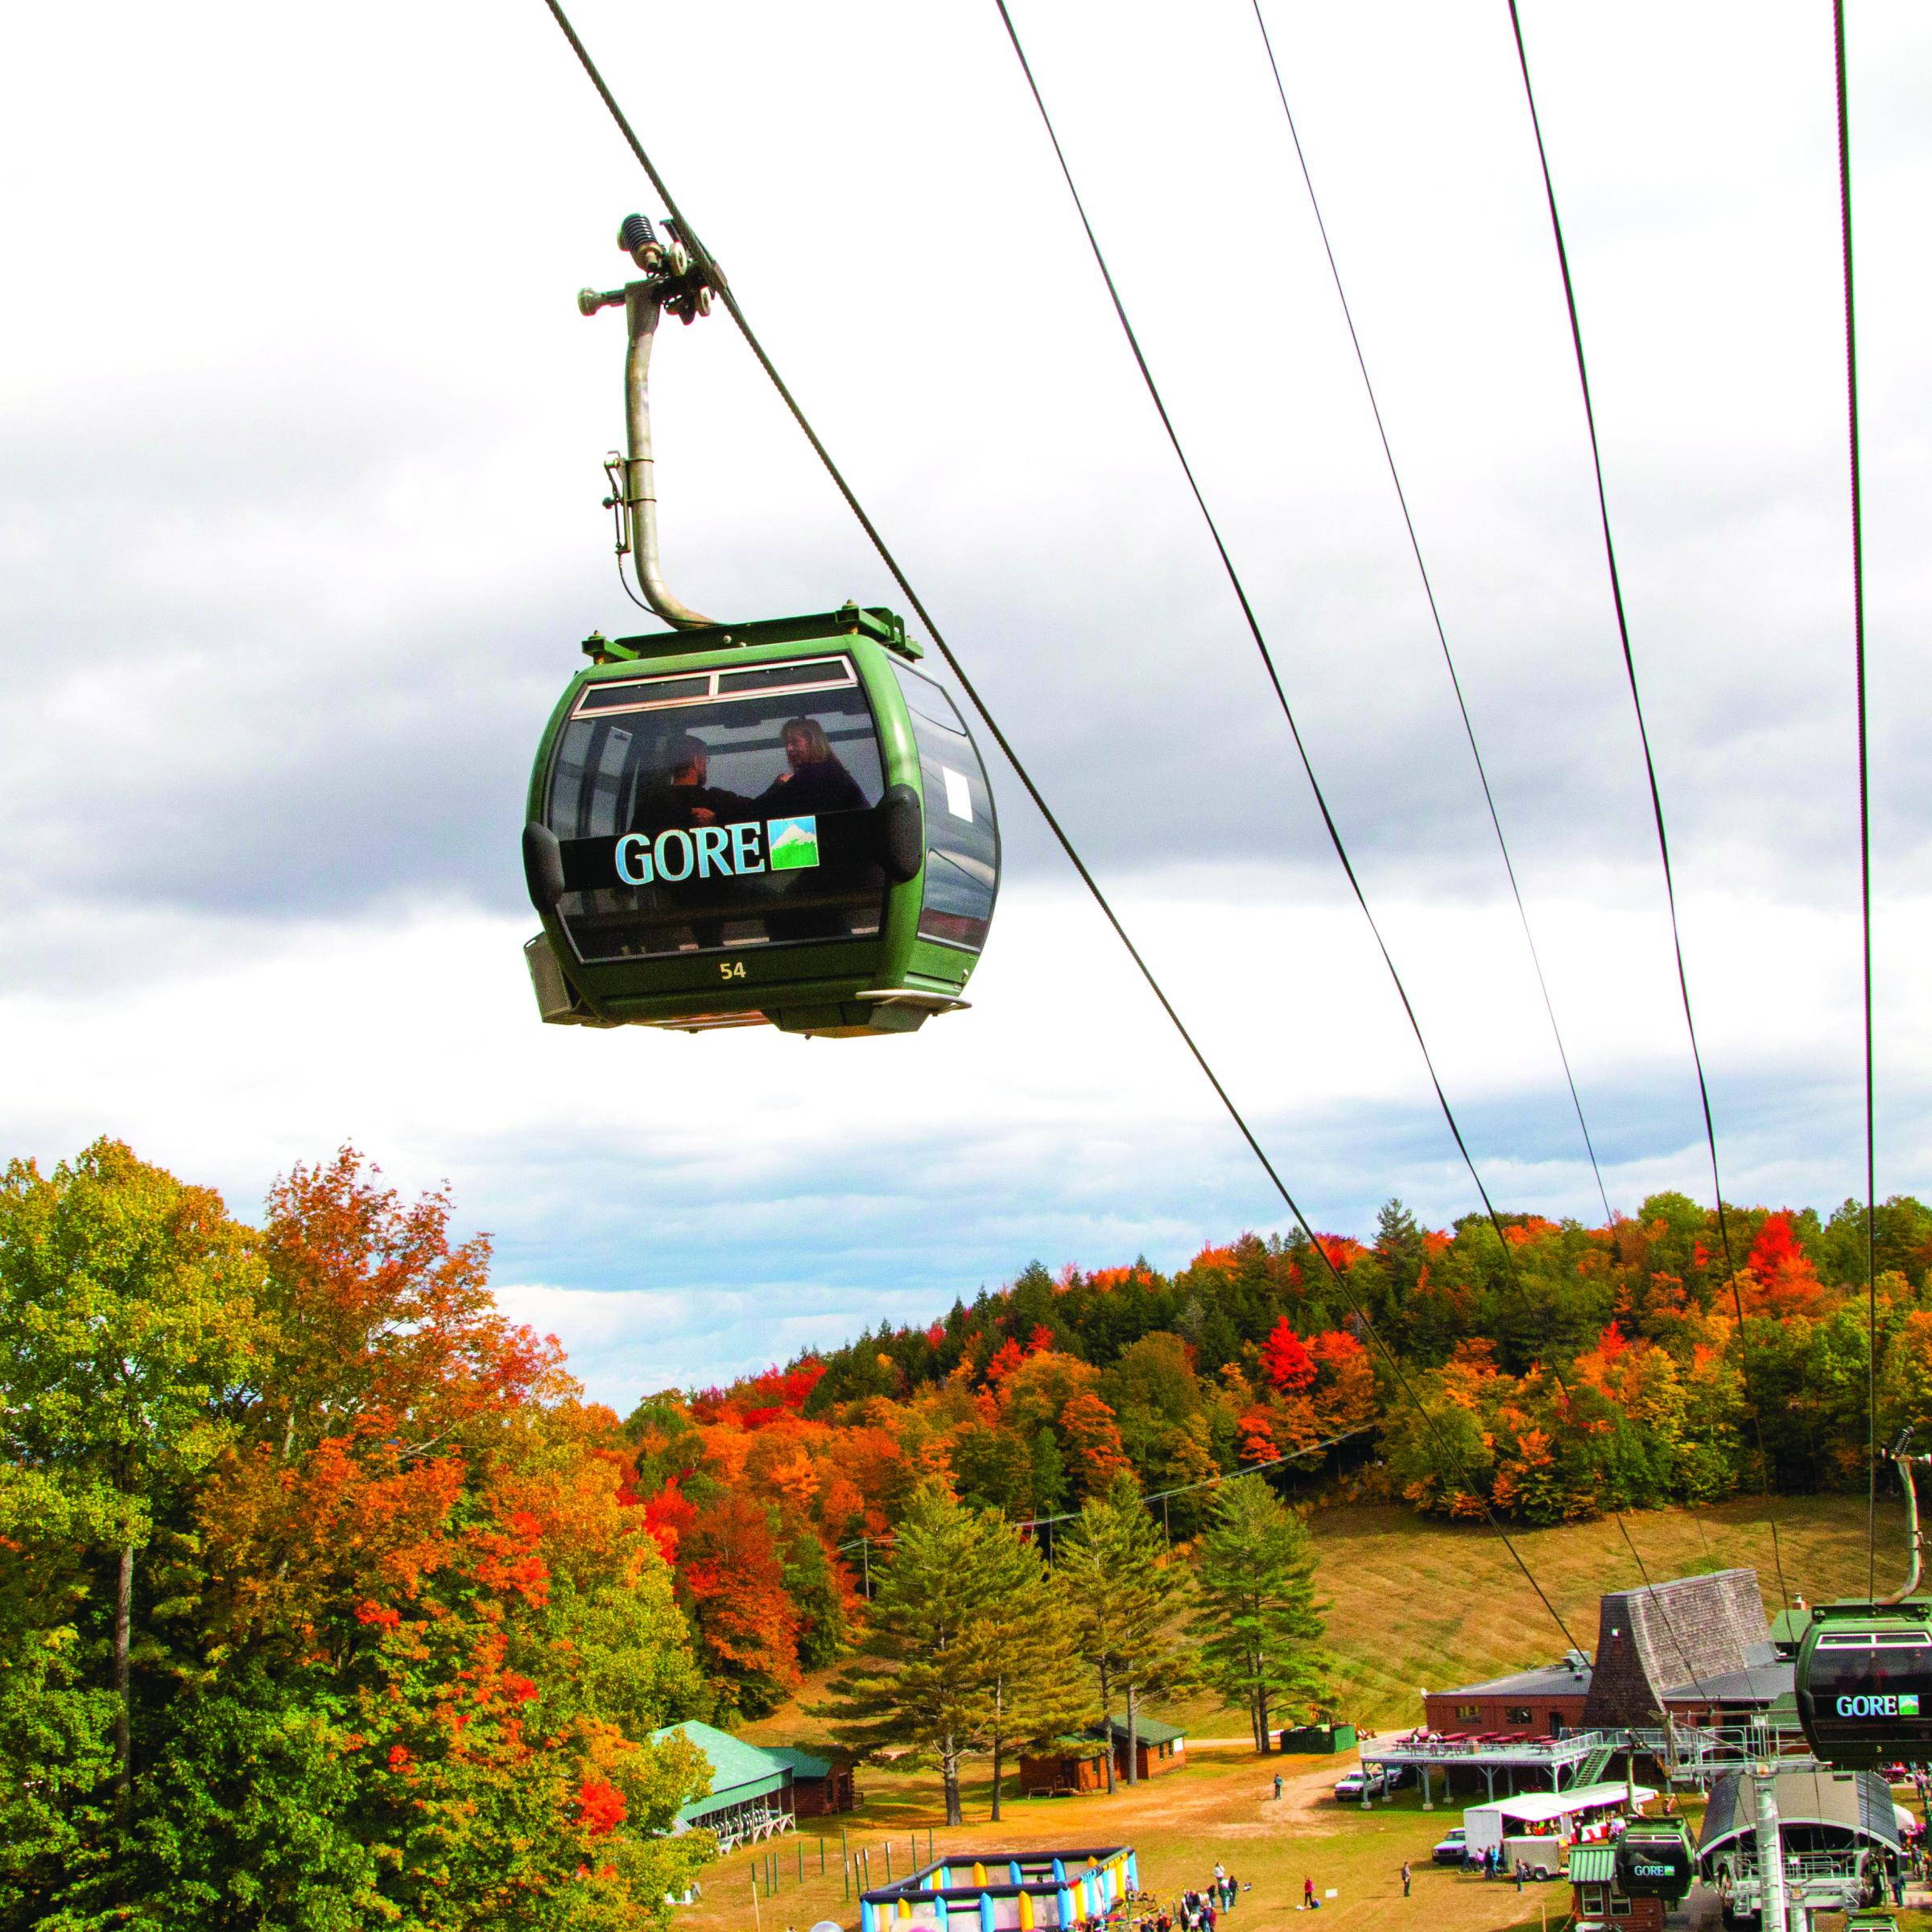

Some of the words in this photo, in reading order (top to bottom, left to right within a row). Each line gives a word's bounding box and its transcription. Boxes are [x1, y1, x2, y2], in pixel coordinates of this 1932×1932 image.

[615, 822, 766, 885] GORE
[720, 962, 746, 980] 54
[1836, 1695, 1898, 1716] GORE
[1634, 1865, 1664, 1876] GORE
